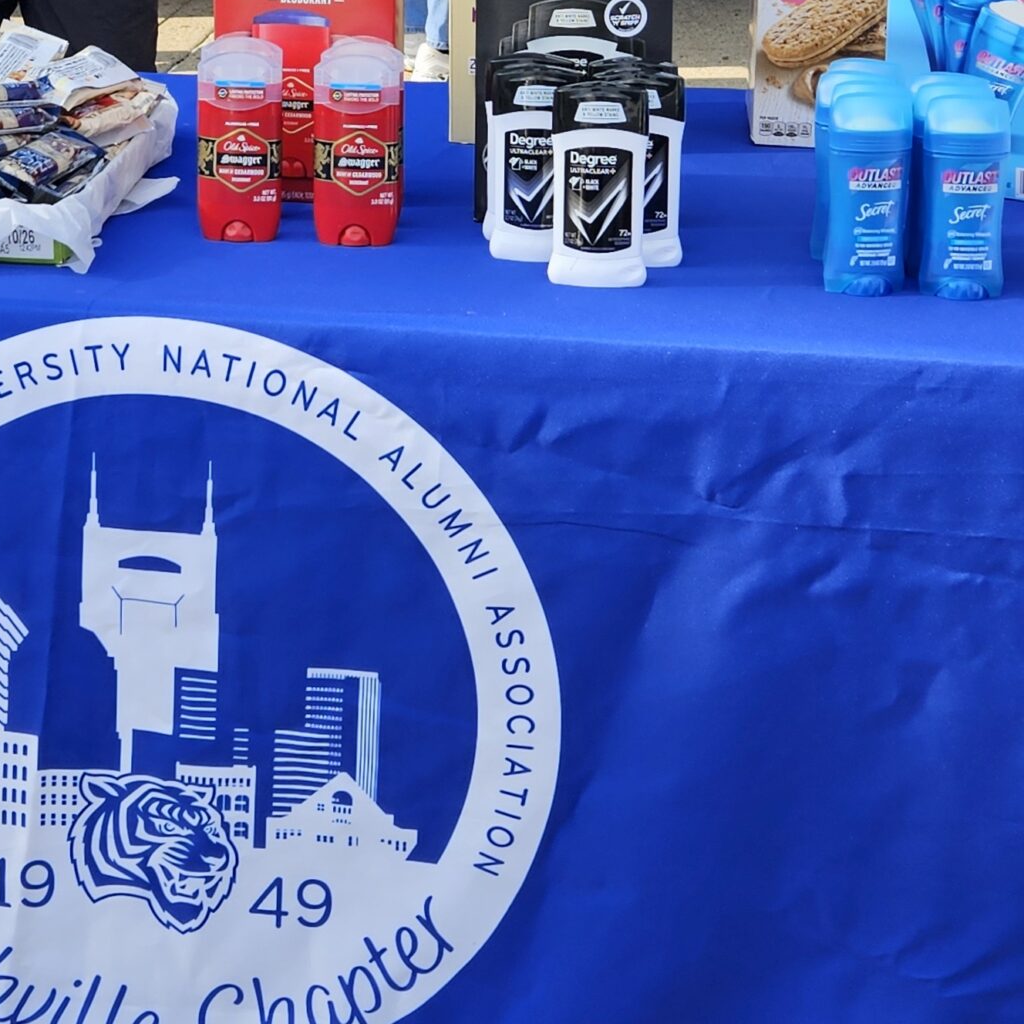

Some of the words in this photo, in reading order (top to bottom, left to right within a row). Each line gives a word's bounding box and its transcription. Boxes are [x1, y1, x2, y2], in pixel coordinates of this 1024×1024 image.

[282, 101, 309, 110] wagger
[510, 132, 553, 149] Degree
[570, 151, 617, 168] Degree
[849, 167, 902, 181] OUTLAST
[942, 170, 999, 185] OUTLAST
[855, 200, 895, 221] Secret
[948, 204, 991, 225] Secret
[163, 344, 361, 441] NATIONAL
[378, 445, 498, 580] ALUMNI
[472, 605, 536, 877] ASSOCIATION
[249, 876, 333, 929] 49
